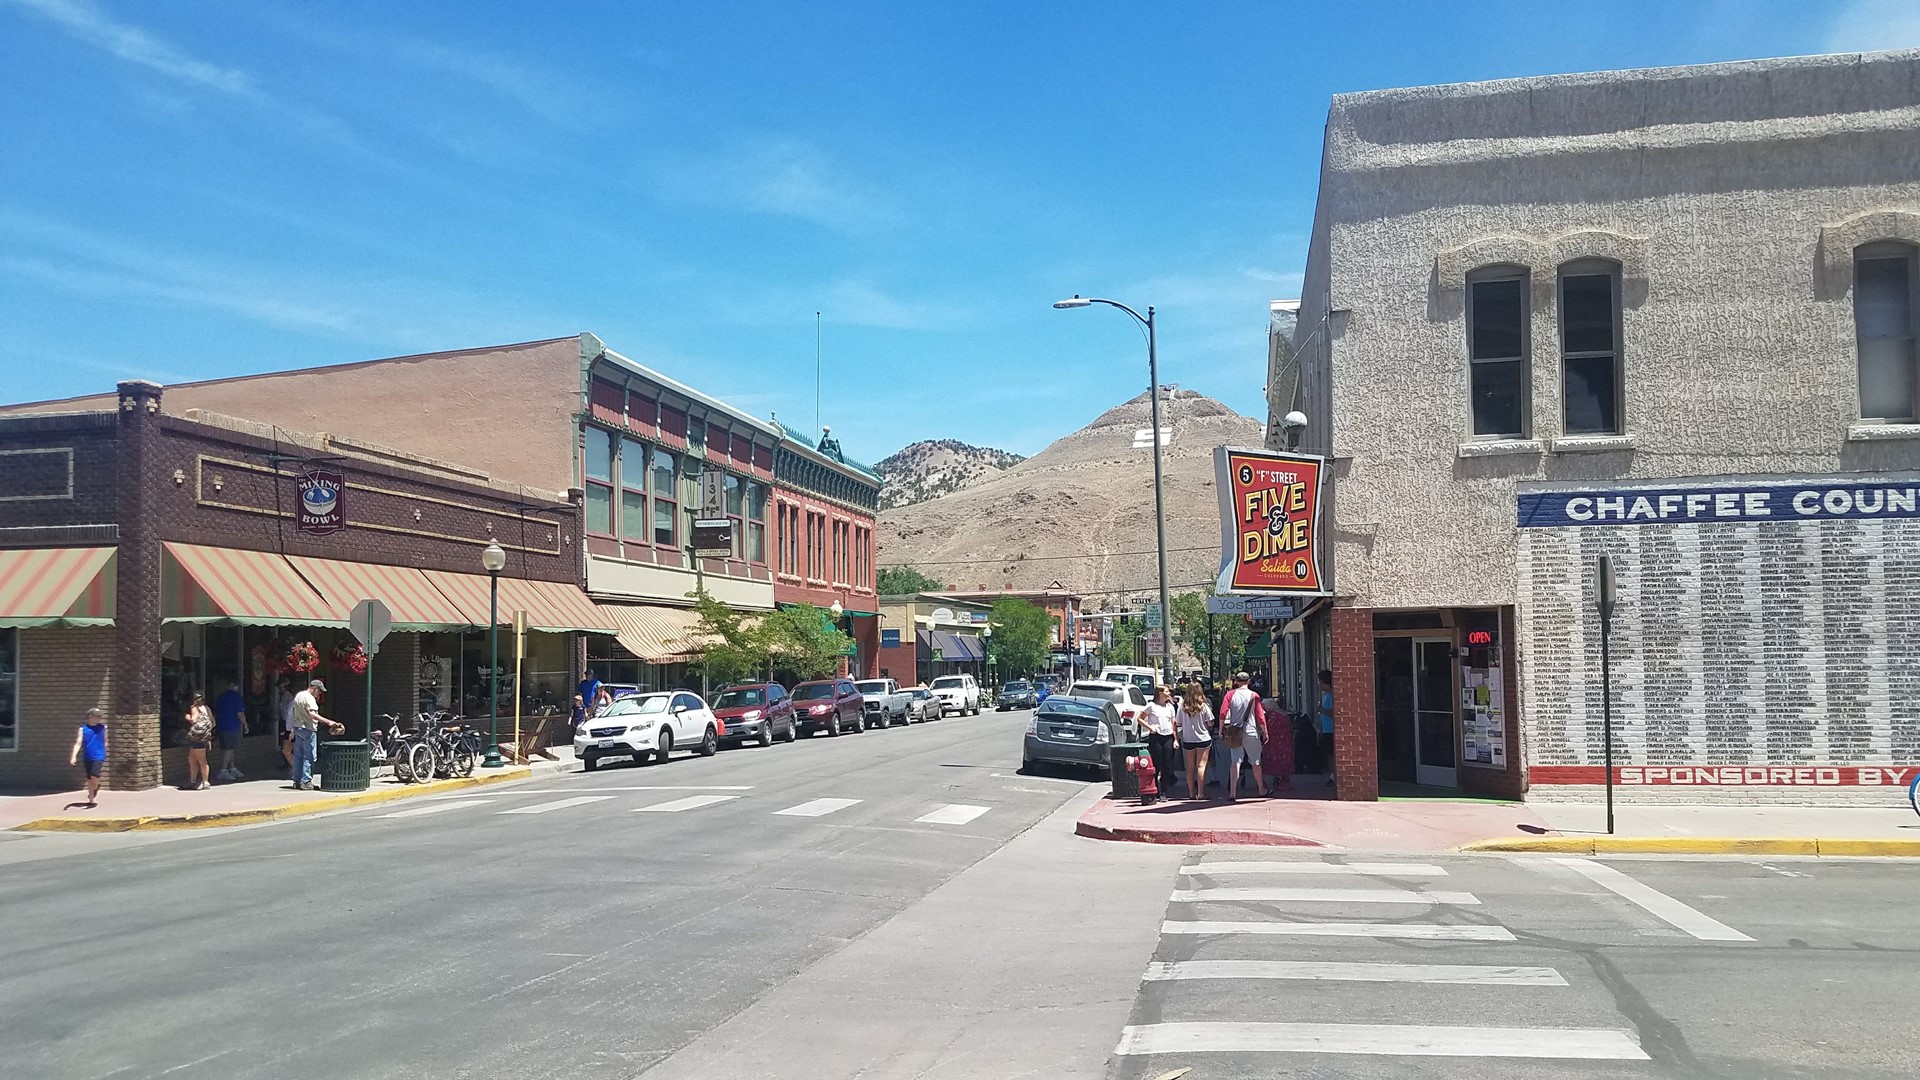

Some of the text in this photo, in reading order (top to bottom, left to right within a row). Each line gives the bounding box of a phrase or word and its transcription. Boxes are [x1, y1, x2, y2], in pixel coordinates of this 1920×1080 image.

[1242, 469, 1250, 482] 5
[1270, 471, 1298, 484] STREET
[298, 479, 341, 492] MIXING
[1245, 481, 1307, 523] FIVE
[1565, 487, 1920, 521] CHAFFEE COUN
[302, 514, 340, 524] BOWL
[1267, 505, 1288, 537] &
[1243, 519, 1308, 563] DIME
[1260, 559, 1292, 574] Salida
[1296, 563, 1307, 576] 10
[1254, 608, 1262, 616] The
[1468, 631, 1491, 644] OPEN
[1620, 767, 1909, 785] SPONSORED BY
